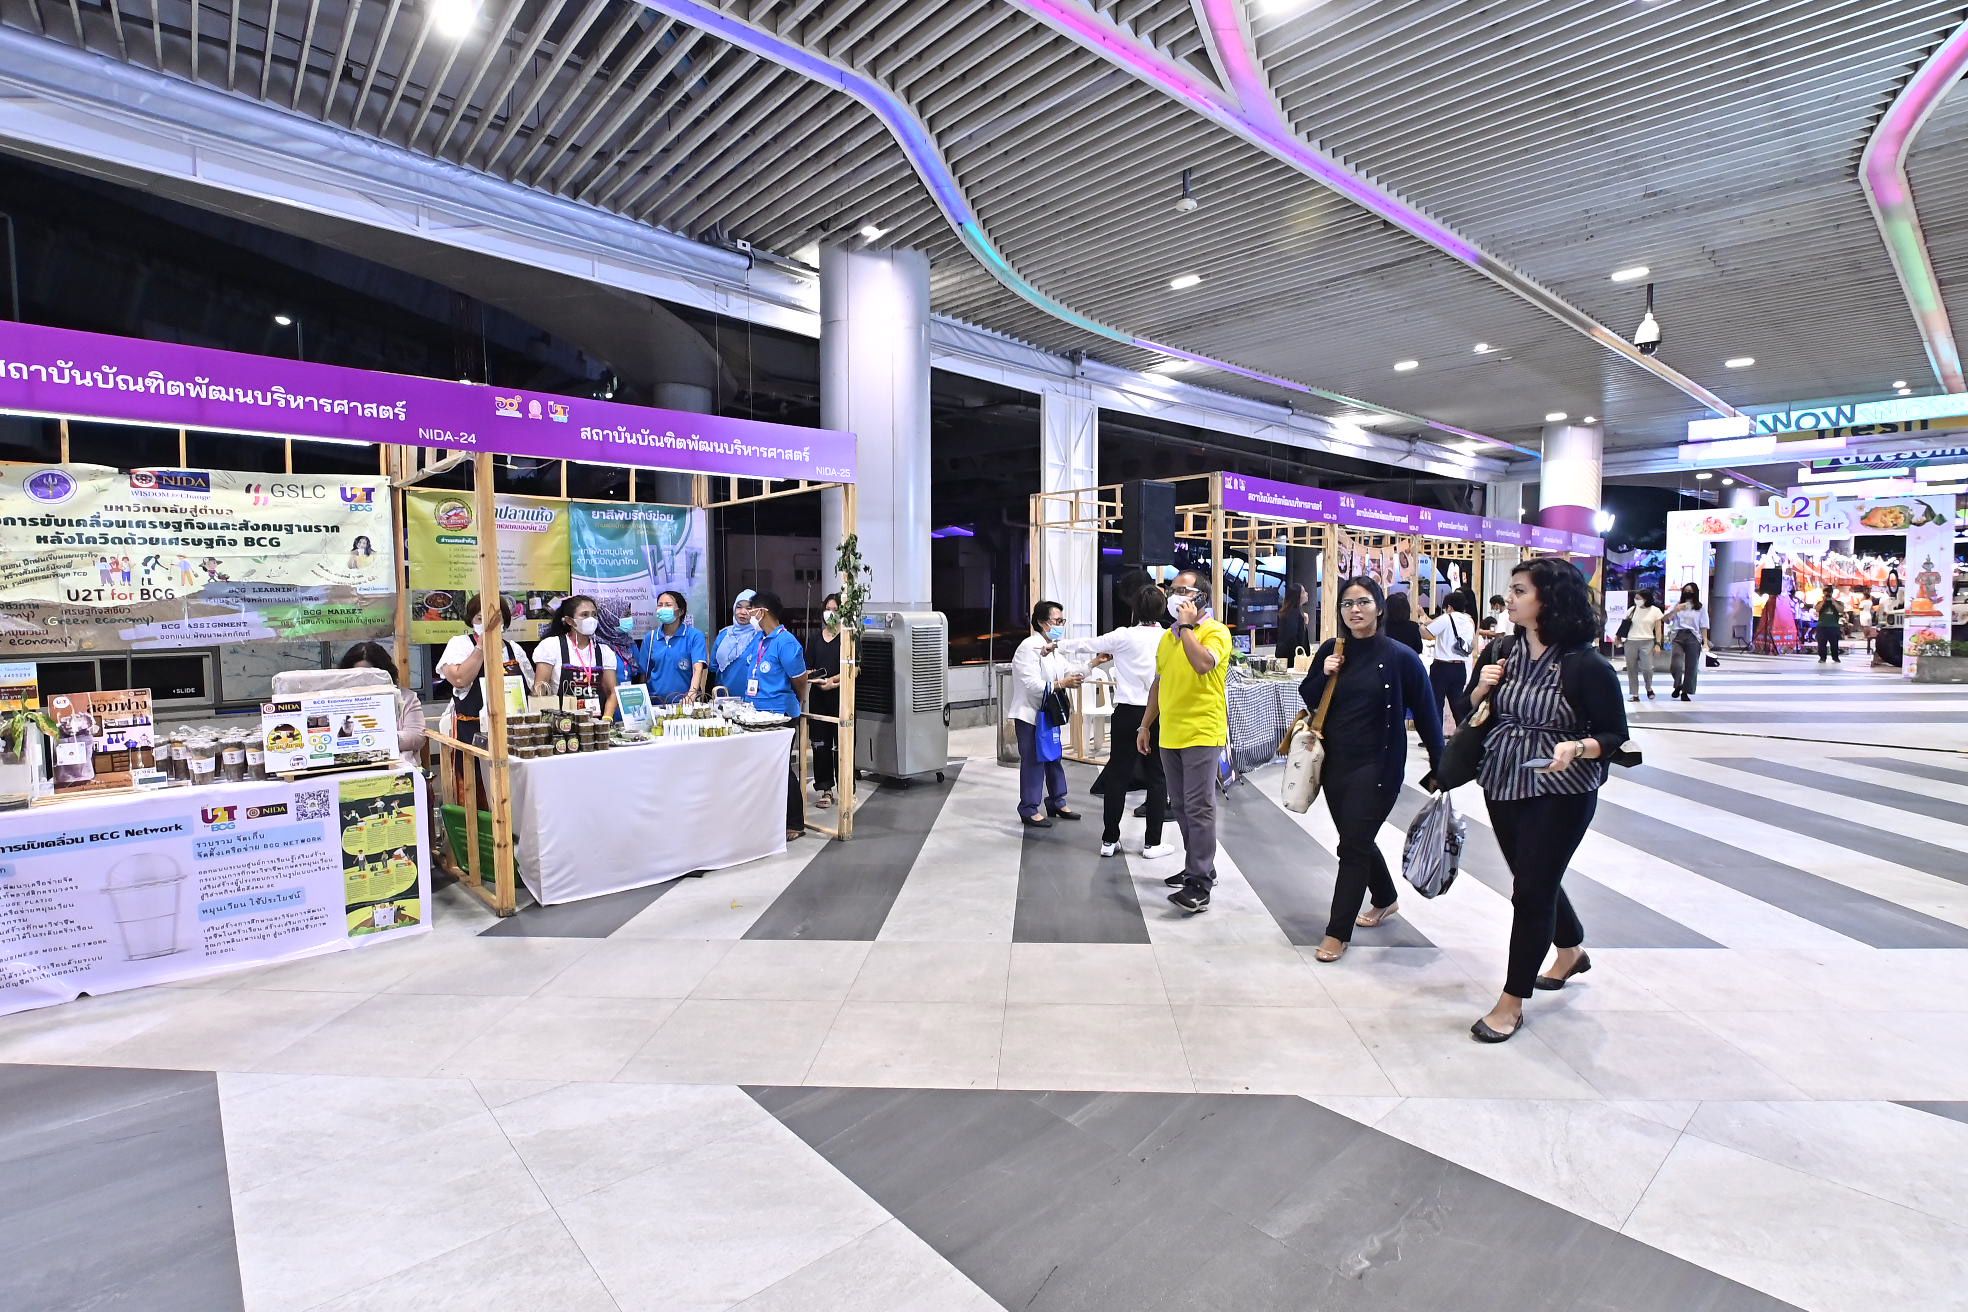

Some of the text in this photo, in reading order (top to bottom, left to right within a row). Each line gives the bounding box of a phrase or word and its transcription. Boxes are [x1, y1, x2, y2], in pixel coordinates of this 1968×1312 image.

[1759, 404, 1856, 433] WOW
[418, 427, 477, 445] NIDA-24
[580, 426, 810, 462] สถาบันบัณฑิตพัฒนบริหารศาสตร์
[816, 465, 851, 478] NIDA-25
[162, 476, 206, 487] NIDA
[270, 483, 326, 499] GSLC
[340, 487, 376, 503] U2T
[350, 504, 373, 512] BCG
[1775, 496, 1829, 518] U2T
[1759, 518, 1844, 533] Market Fair
[36, 531, 281, 549] หลังโควิดด้วยเศรษฐกิจ BCG
[1793, 536, 1821, 545] Chula
[67, 589, 174, 601] U2T for BCG
[95, 616, 155, 627] economy)
[188, 621, 248, 629] ASSIGNMENT
[201, 806, 237, 824] U2T
[262, 806, 286, 815] NIDA
[89, 831, 120, 842] BCG
[125, 823, 183, 838] Network
[211, 822, 236, 832] BCG
[283, 836, 322, 847] NETWORK
[42, 945, 68, 953] MODEL
